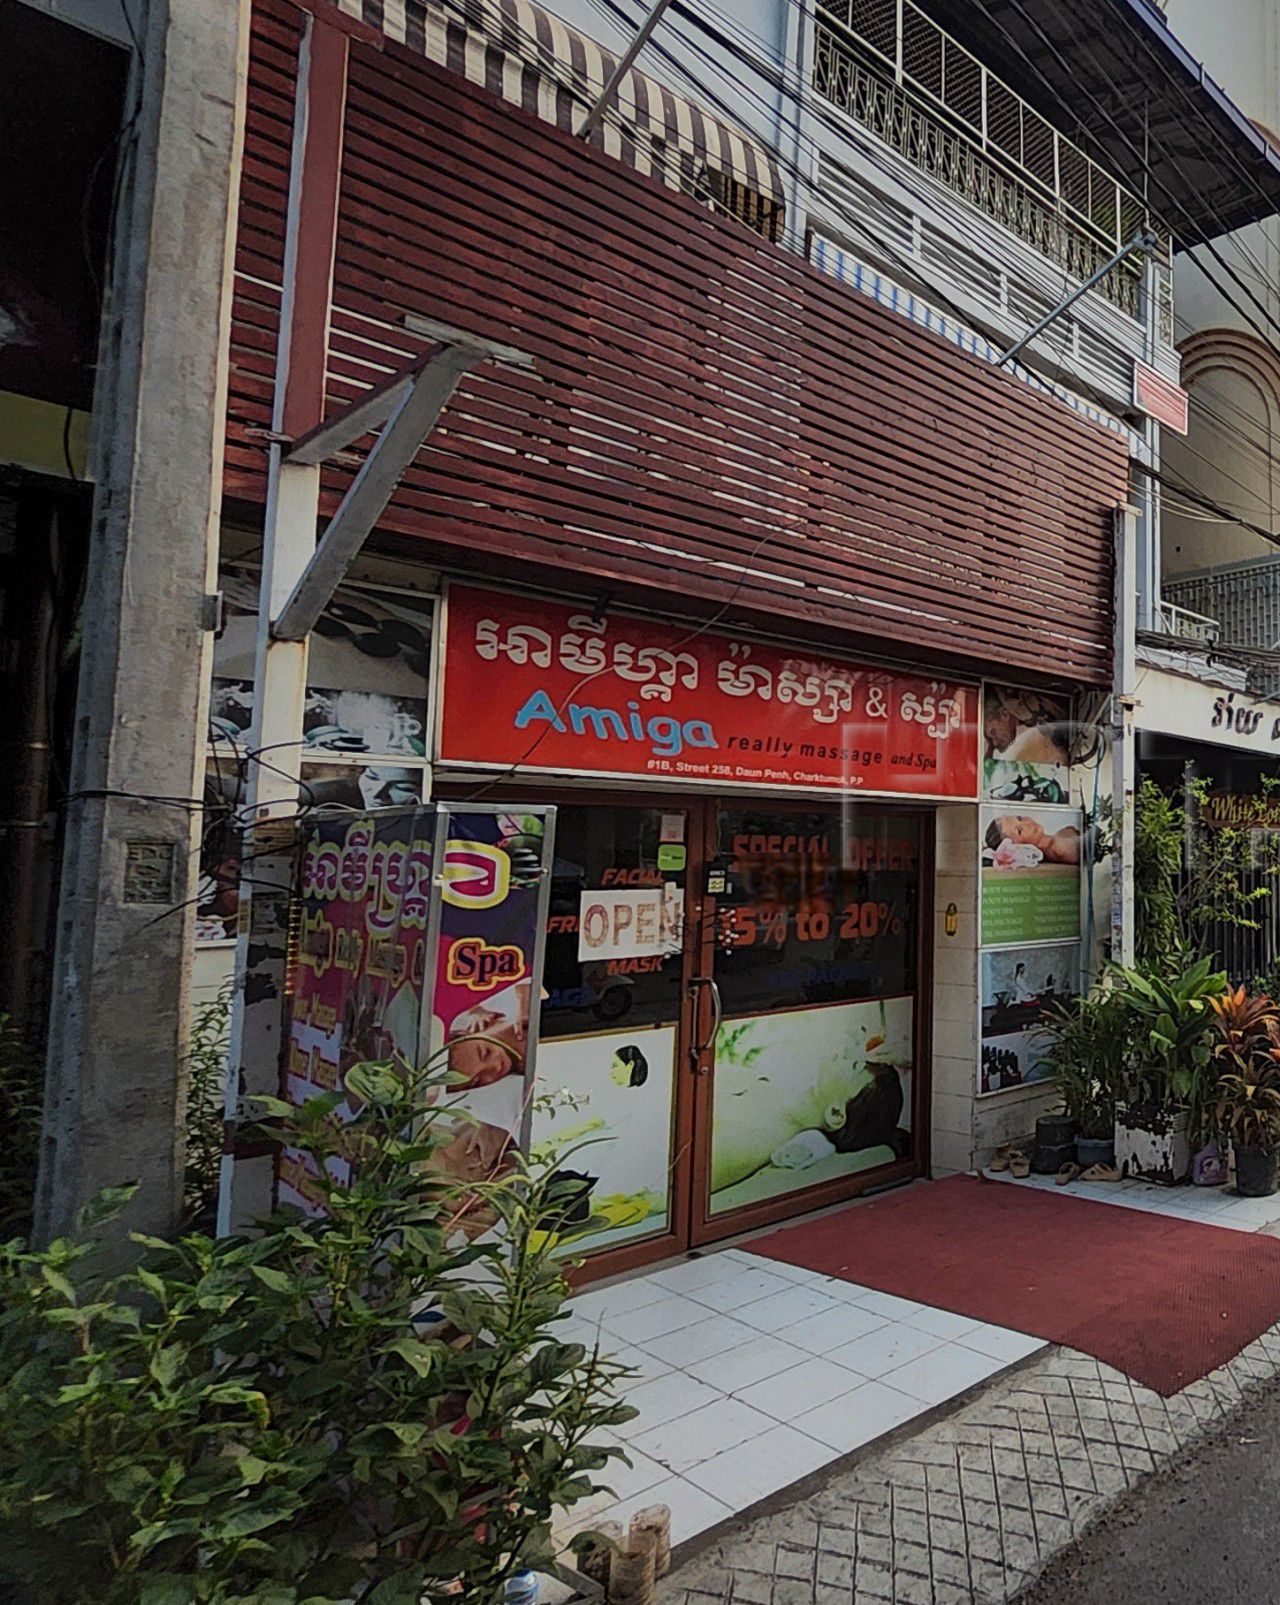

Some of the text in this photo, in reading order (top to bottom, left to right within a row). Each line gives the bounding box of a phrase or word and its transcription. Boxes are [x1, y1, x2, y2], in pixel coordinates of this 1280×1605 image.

[866, 687, 888, 719] &
[514, 689, 937, 770] Amiga really massage and Spa
[676, 762, 709, 774] Street
[601, 867, 665, 886] FACIAL
[583, 901, 682, 948] OPEN
[795, 903, 832, 942] to
[839, 900, 905, 938] 20%
[455, 943, 520, 986] Spa
[607, 956, 664, 975] MASK
